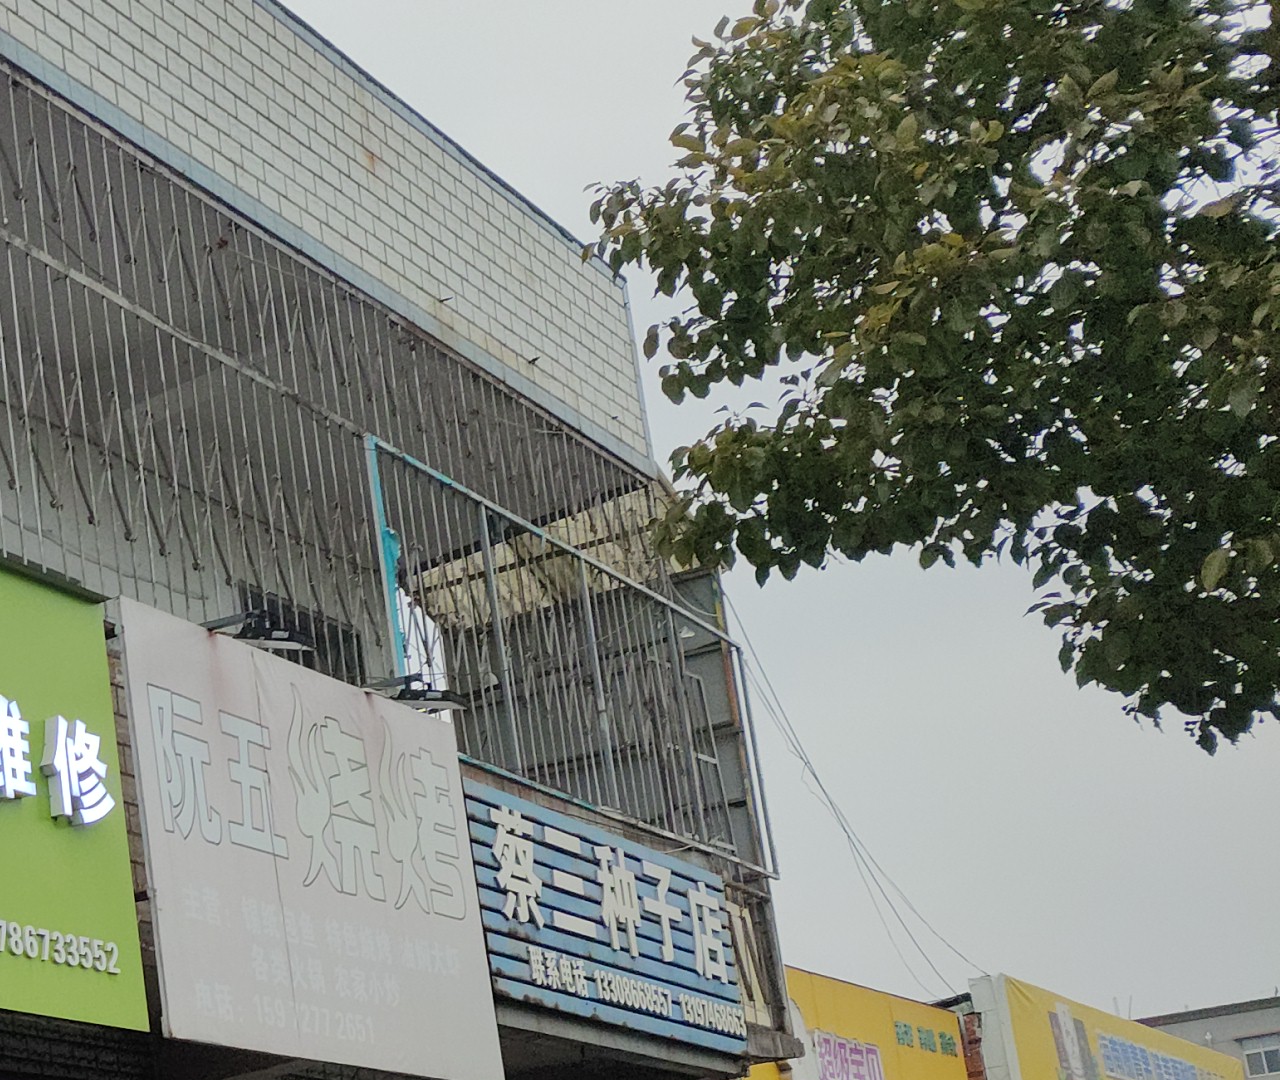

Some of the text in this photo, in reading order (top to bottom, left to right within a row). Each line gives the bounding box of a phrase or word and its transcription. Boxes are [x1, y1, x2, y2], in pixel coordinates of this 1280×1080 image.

[490, 803, 729, 986] 蔡三种子店
[527, 944, 589, 999] 联系电话
